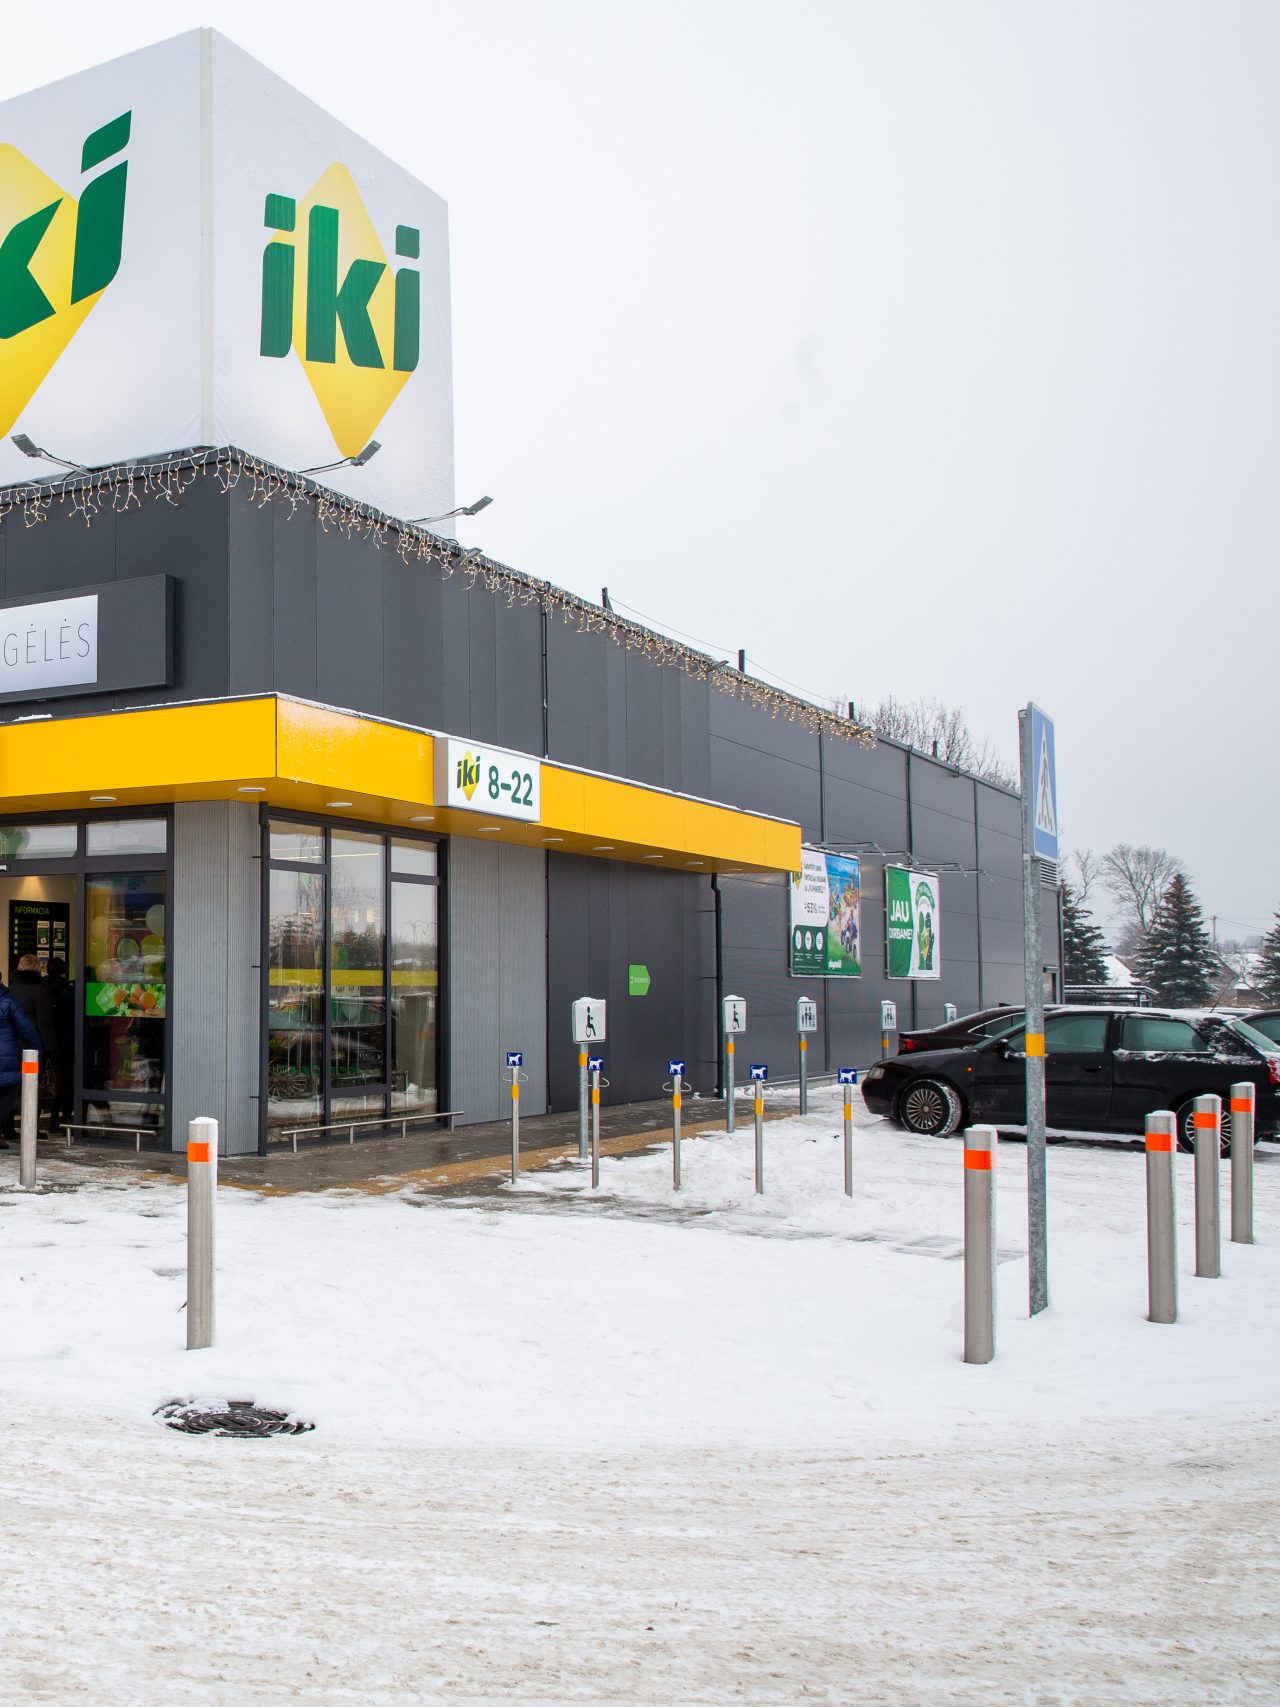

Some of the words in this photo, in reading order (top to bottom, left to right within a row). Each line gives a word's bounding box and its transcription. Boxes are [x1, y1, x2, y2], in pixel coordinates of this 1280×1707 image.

[260, 193, 420, 372] iki
[3, 618, 90, 666] GĖLĖS
[457, 756, 480, 788] iki
[488, 765, 533, 806] 8-22
[890, 900, 910, 923] JAU
